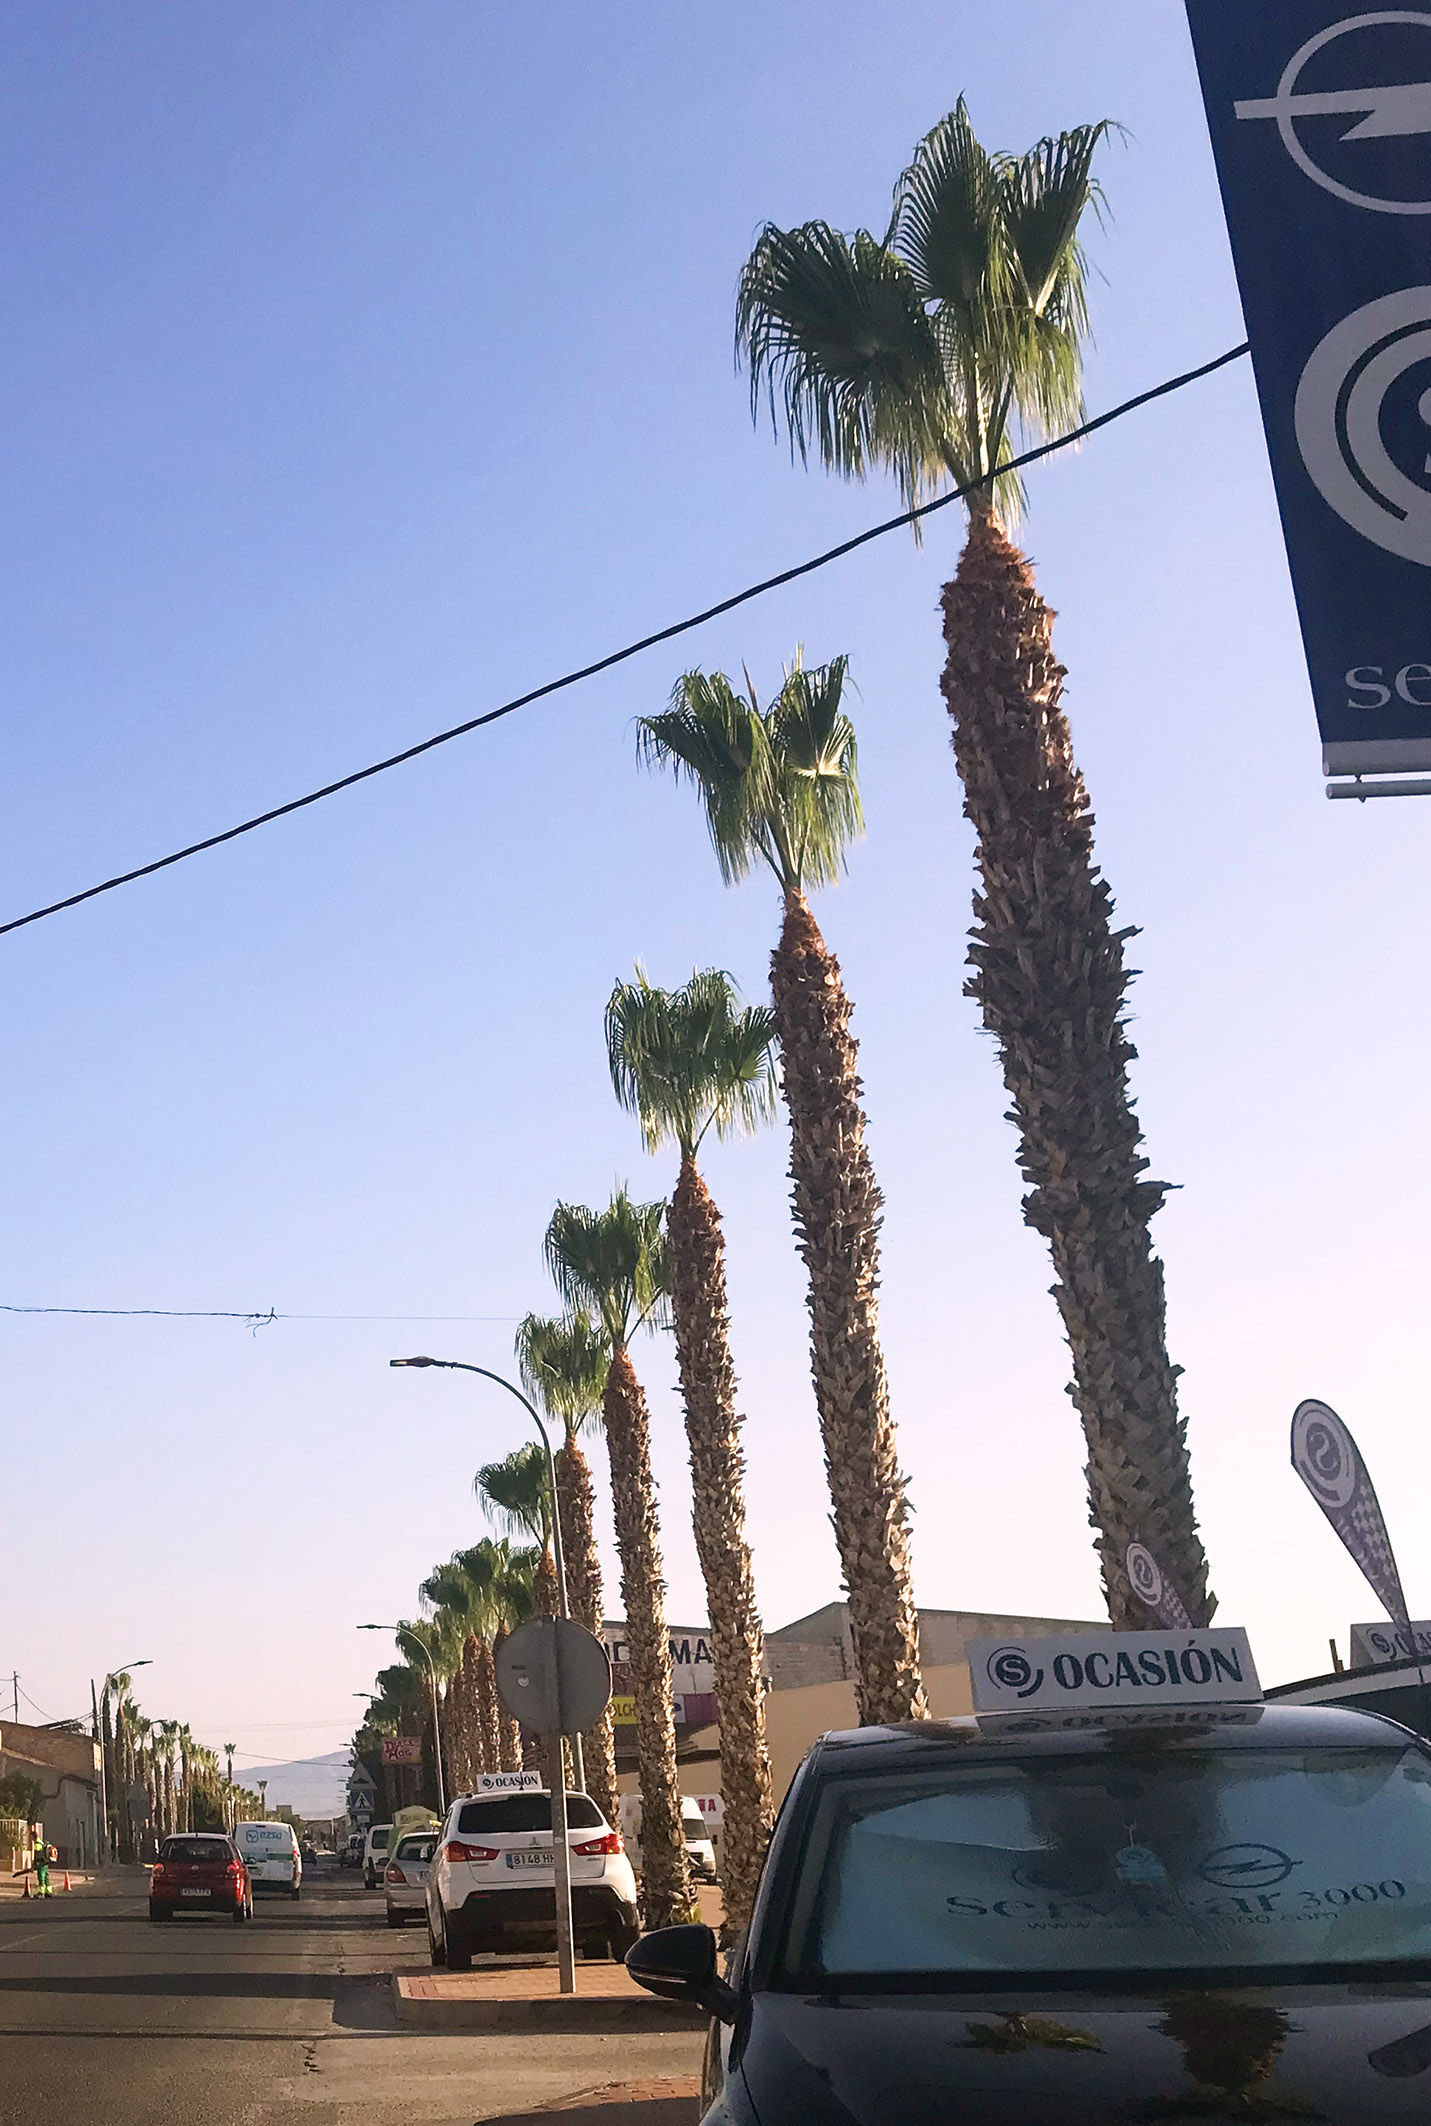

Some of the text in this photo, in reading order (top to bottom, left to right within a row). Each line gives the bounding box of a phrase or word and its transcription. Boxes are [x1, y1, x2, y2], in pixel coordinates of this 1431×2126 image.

[1053, 1640, 1243, 1690] OCASIÓN
[495, 1774, 538, 1787] OCASIÓN
[1302, 1879, 1407, 1908] 3000
